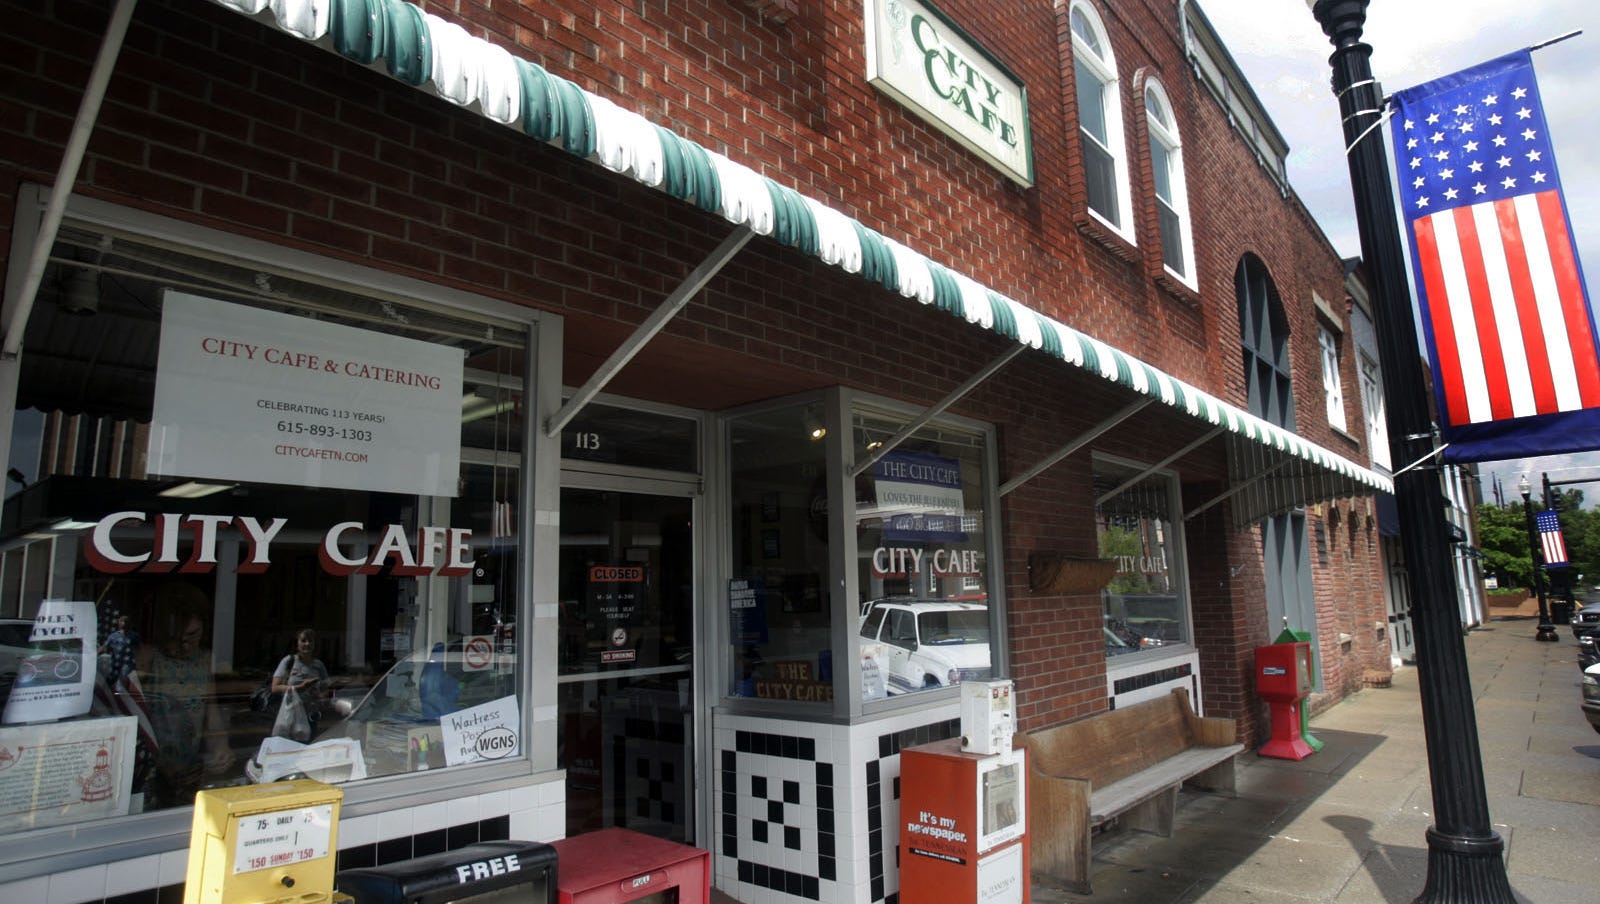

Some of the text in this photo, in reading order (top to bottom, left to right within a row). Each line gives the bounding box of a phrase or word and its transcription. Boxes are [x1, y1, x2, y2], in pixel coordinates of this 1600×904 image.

[911, 14, 1002, 108] CITY
[924, 49, 1018, 149] CAFE
[201, 337, 441, 390] CITY CAFE & CATERING
[256, 399, 385, 424] CELEBRATING 113 YEARS!
[277, 420, 373, 442] 615-893-1303
[575, 432, 600, 450] 113
[275, 445, 368, 463] CITYCAFETN.COM
[882, 461, 959, 485] THE CITY CAFE
[86, 511, 476, 576] CITY CAFE
[872, 547, 980, 577] CITY CAFE
[594, 568, 639, 580] CLOSED
[776, 663, 809, 680] THE
[756, 680, 833, 701] CITY CAFE
[452, 711, 500, 732] Waitress
[479, 735, 514, 751] WGNS
[277, 816, 293, 825] DAILY
[920, 811, 956, 830] It's my
[908, 823, 967, 843] newspaper.
[270, 852, 293, 862] SUNDAY
[456, 854, 521, 884] FREE
[632, 875, 650, 888] PULL
